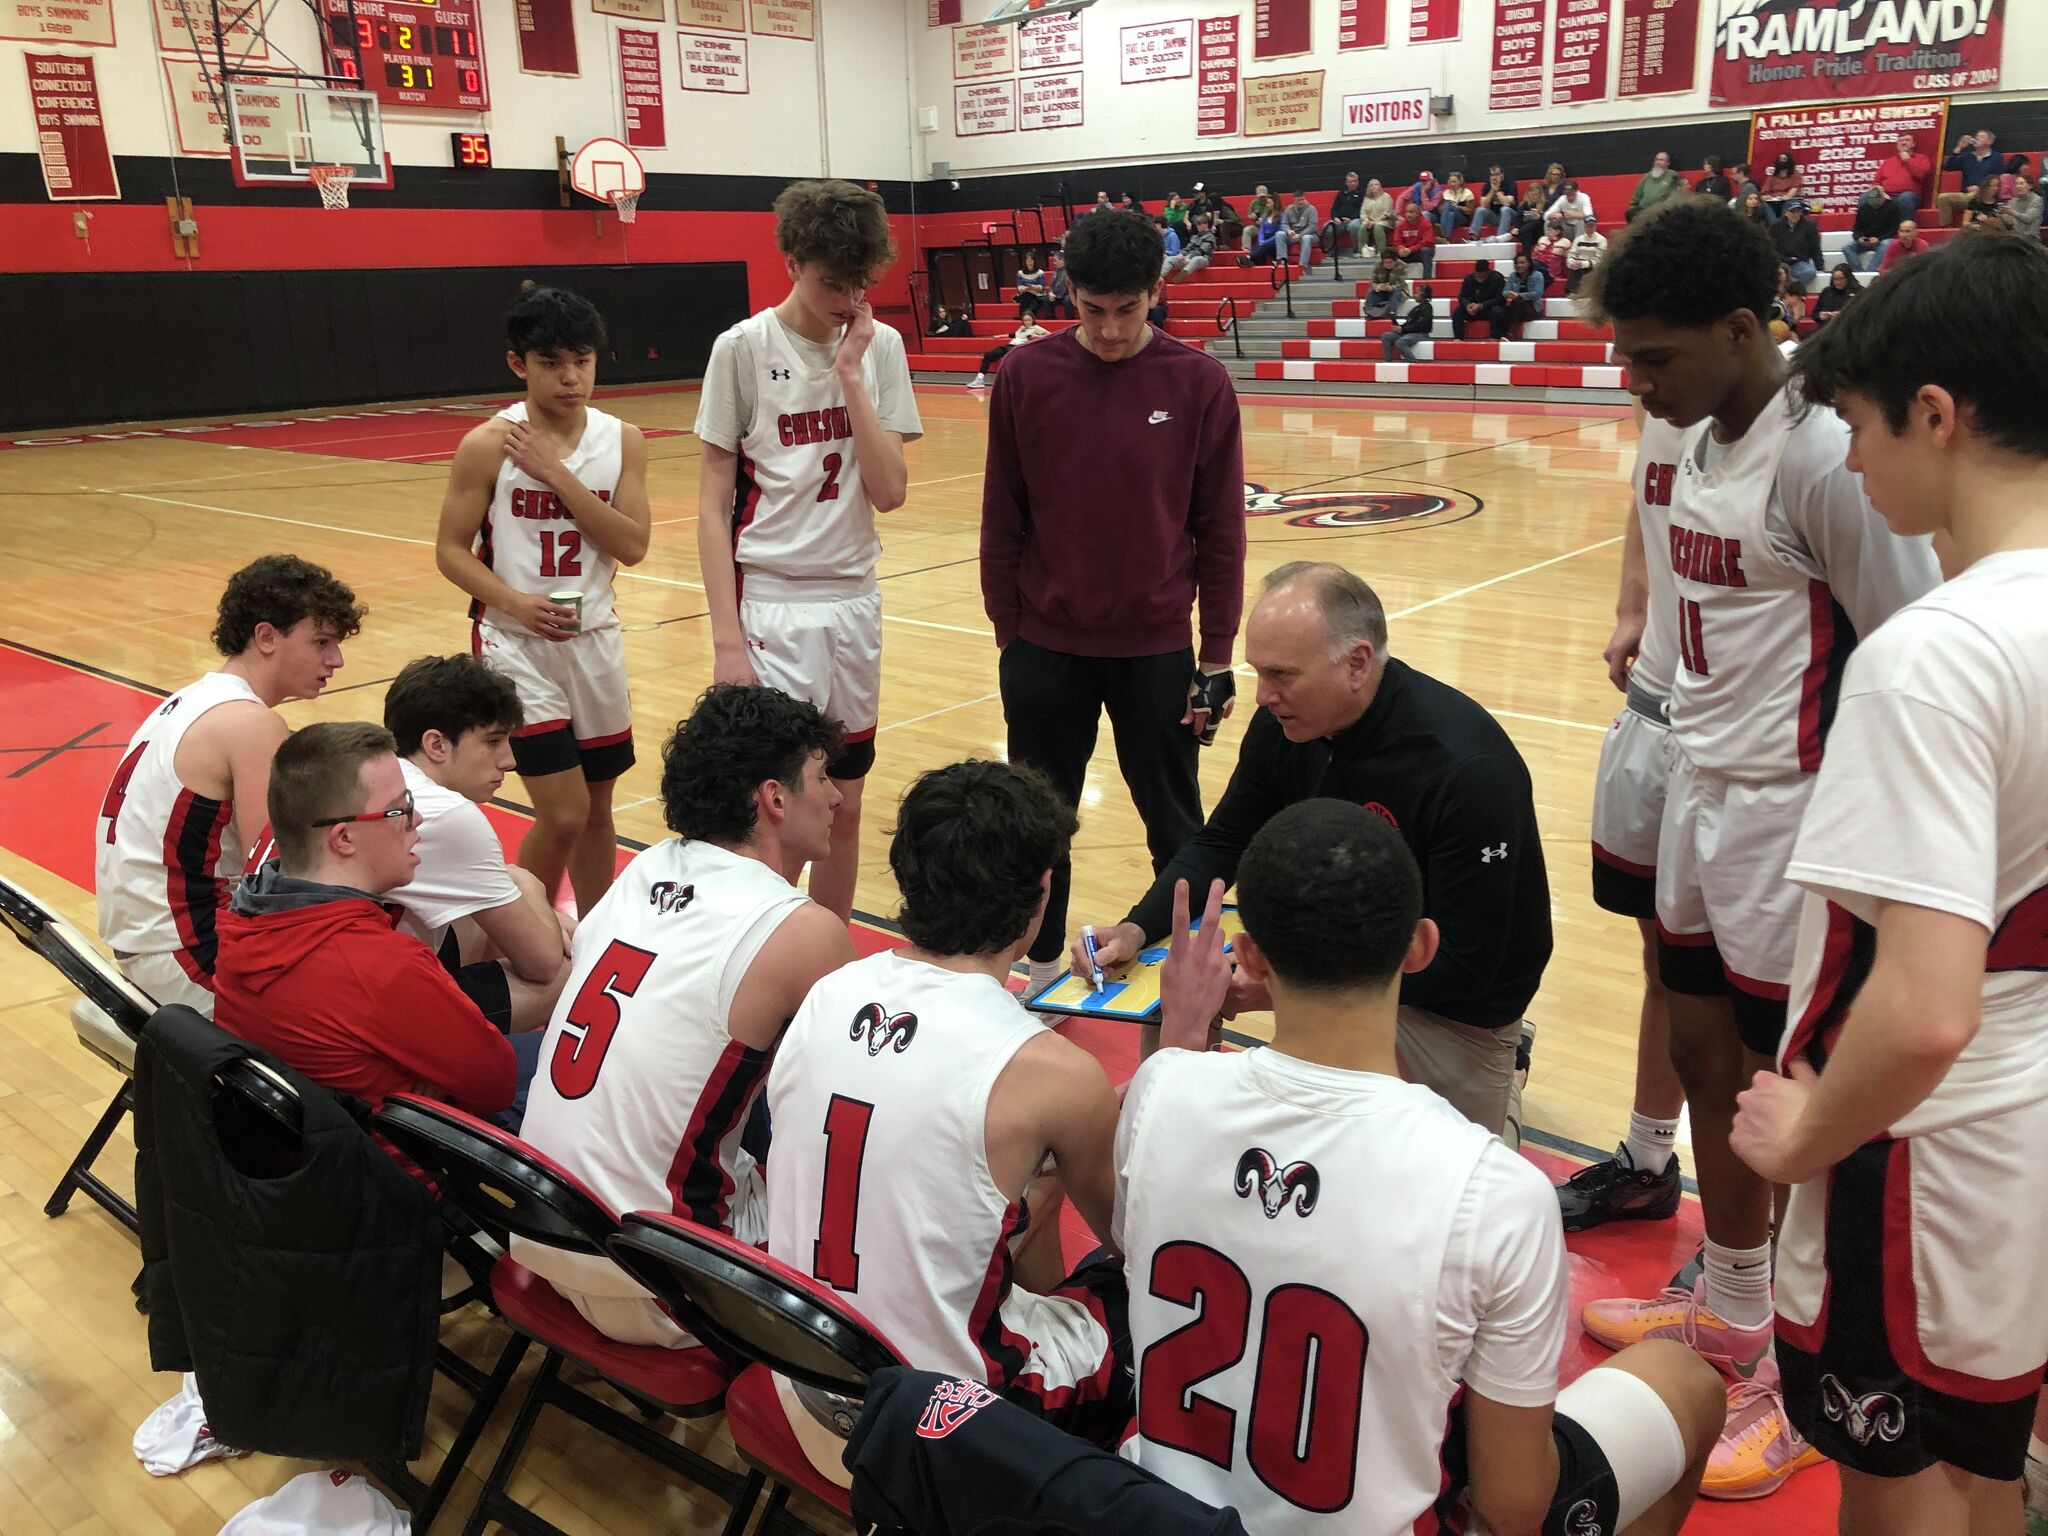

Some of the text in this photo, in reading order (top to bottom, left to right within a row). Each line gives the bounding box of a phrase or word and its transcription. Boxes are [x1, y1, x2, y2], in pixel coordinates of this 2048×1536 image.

[18, 5, 91, 22] BOYS SWIMMING
[330, 0, 386, 18] CHSHIRE
[691, 1, 730, 14] BASEBALL
[1505, 7, 1535, 21] DIVISION
[388, 12, 417, 25] PERIOD
[435, 10, 470, 27] GUEST
[768, 9, 799, 23] BASEBALL
[1560, 12, 1608, 29] CHAMPIONS
[1042, 22, 1080, 36] LACROSSE
[1138, 27, 1176, 39] CHESHIRE
[1205, 20, 1233, 33] SCC
[1497, 21, 1542, 37] CHAMPIONS
[1726, 0, 1992, 61] RAMLAND!
[400, 26, 412, 50] 2
[452, 30, 476, 57] 11
[1036, 37, 1053, 46] TOP
[1564, 29, 1600, 43] BOYS
[695, 40, 732, 51] CHESHIRE
[1501, 37, 1536, 51] BOYS
[1563, 43, 1601, 59] GOLF
[384, 53, 434, 68] PLAYER FOUL
[456, 59, 480, 71] FOULS
[686, 51, 703, 62] STATE
[715, 53, 743, 65] CHAMPIONS
[1130, 52, 1185, 67] BOYS SOCCER
[1201, 58, 1238, 70] CHAMPIONS
[1501, 52, 1535, 66] GOLF
[36, 61, 87, 76] SOUTHERN
[691, 64, 739, 77] BASEBALL
[1749, 50, 1966, 84] Honor. Pride. Tradition.
[465, 70, 480, 93] 0
[1208, 71, 1231, 82] BOYS
[1913, 67, 1999, 90] CLASS OF 2004
[33, 78, 94, 93] CONNECTICUT
[1201, 83, 1237, 95] SOCCER
[1258, 78, 1310, 91] CHESHIRE
[38, 95, 97, 110] CONFERENCE
[236, 92, 281, 109] CHAMPIONS
[399, 91, 426, 103] MATCH
[459, 95, 484, 106] SCORE
[1248, 95, 1268, 106] STATE
[1282, 89, 1320, 102] CHAMPIONS
[1023, 101, 1081, 117] BOYS LACROSSE
[1257, 103, 1310, 117] BOYS SOCCER
[1349, 99, 1425, 125] VISITORS
[1756, 101, 1944, 130] A FALL CLEAN SWEEP!
[40, 113, 101, 128] BOYS SWIMMING
[1760, 118, 1936, 140] SOUTHERN CONNECTICUT CONFERENCE
[1791, 132, 1900, 151] LEAGUE TITLES
[460, 136, 490, 165] 35
[1819, 146, 1867, 161] 2022
[1807, 161, 1853, 174] CROSS
[816, 452, 842, 502] 2
[539, 530, 582, 577] 12
[1679, 596, 1709, 677] 11
[101, 740, 150, 845] 4
[550, 938, 658, 1101] 5
[813, 1093, 875, 1294] 1
[1138, 1239, 1370, 1515] 20
